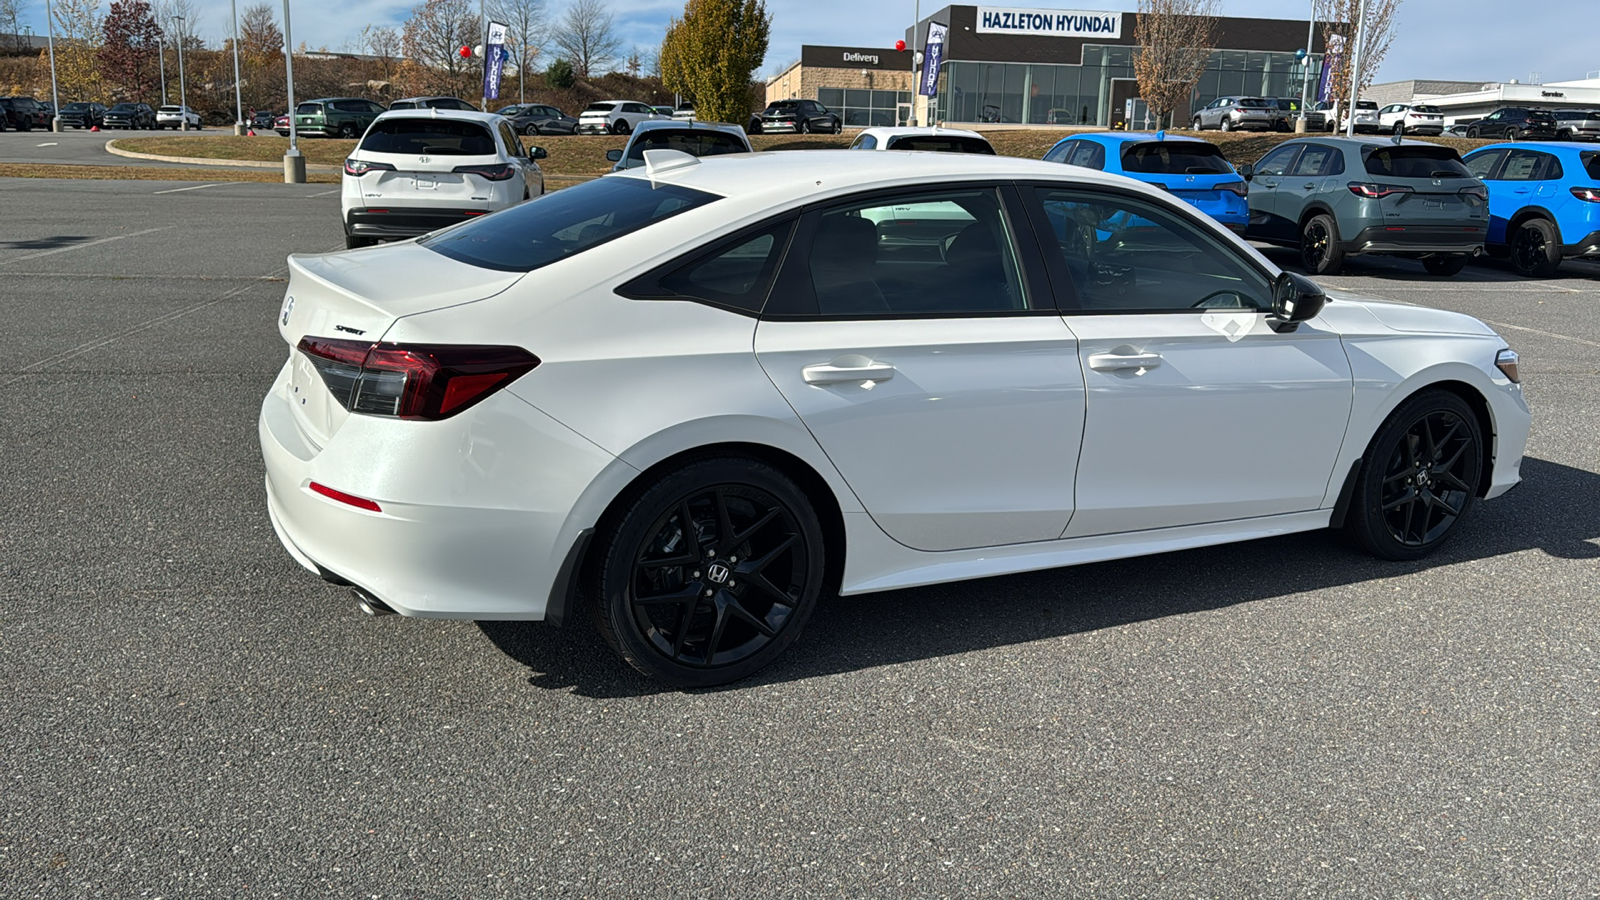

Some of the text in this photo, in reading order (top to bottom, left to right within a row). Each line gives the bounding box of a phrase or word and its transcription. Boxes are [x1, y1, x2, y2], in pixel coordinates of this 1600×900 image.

[982, 12, 1116, 33] HAZLETON HYUNDAI
[843, 52, 879, 65] Delivery
[490, 46, 501, 98] HYUNDAI
[926, 46, 939, 94] HYUNDAI
[1541, 90, 1564, 98] Service
[334, 325, 367, 336] SPORT
